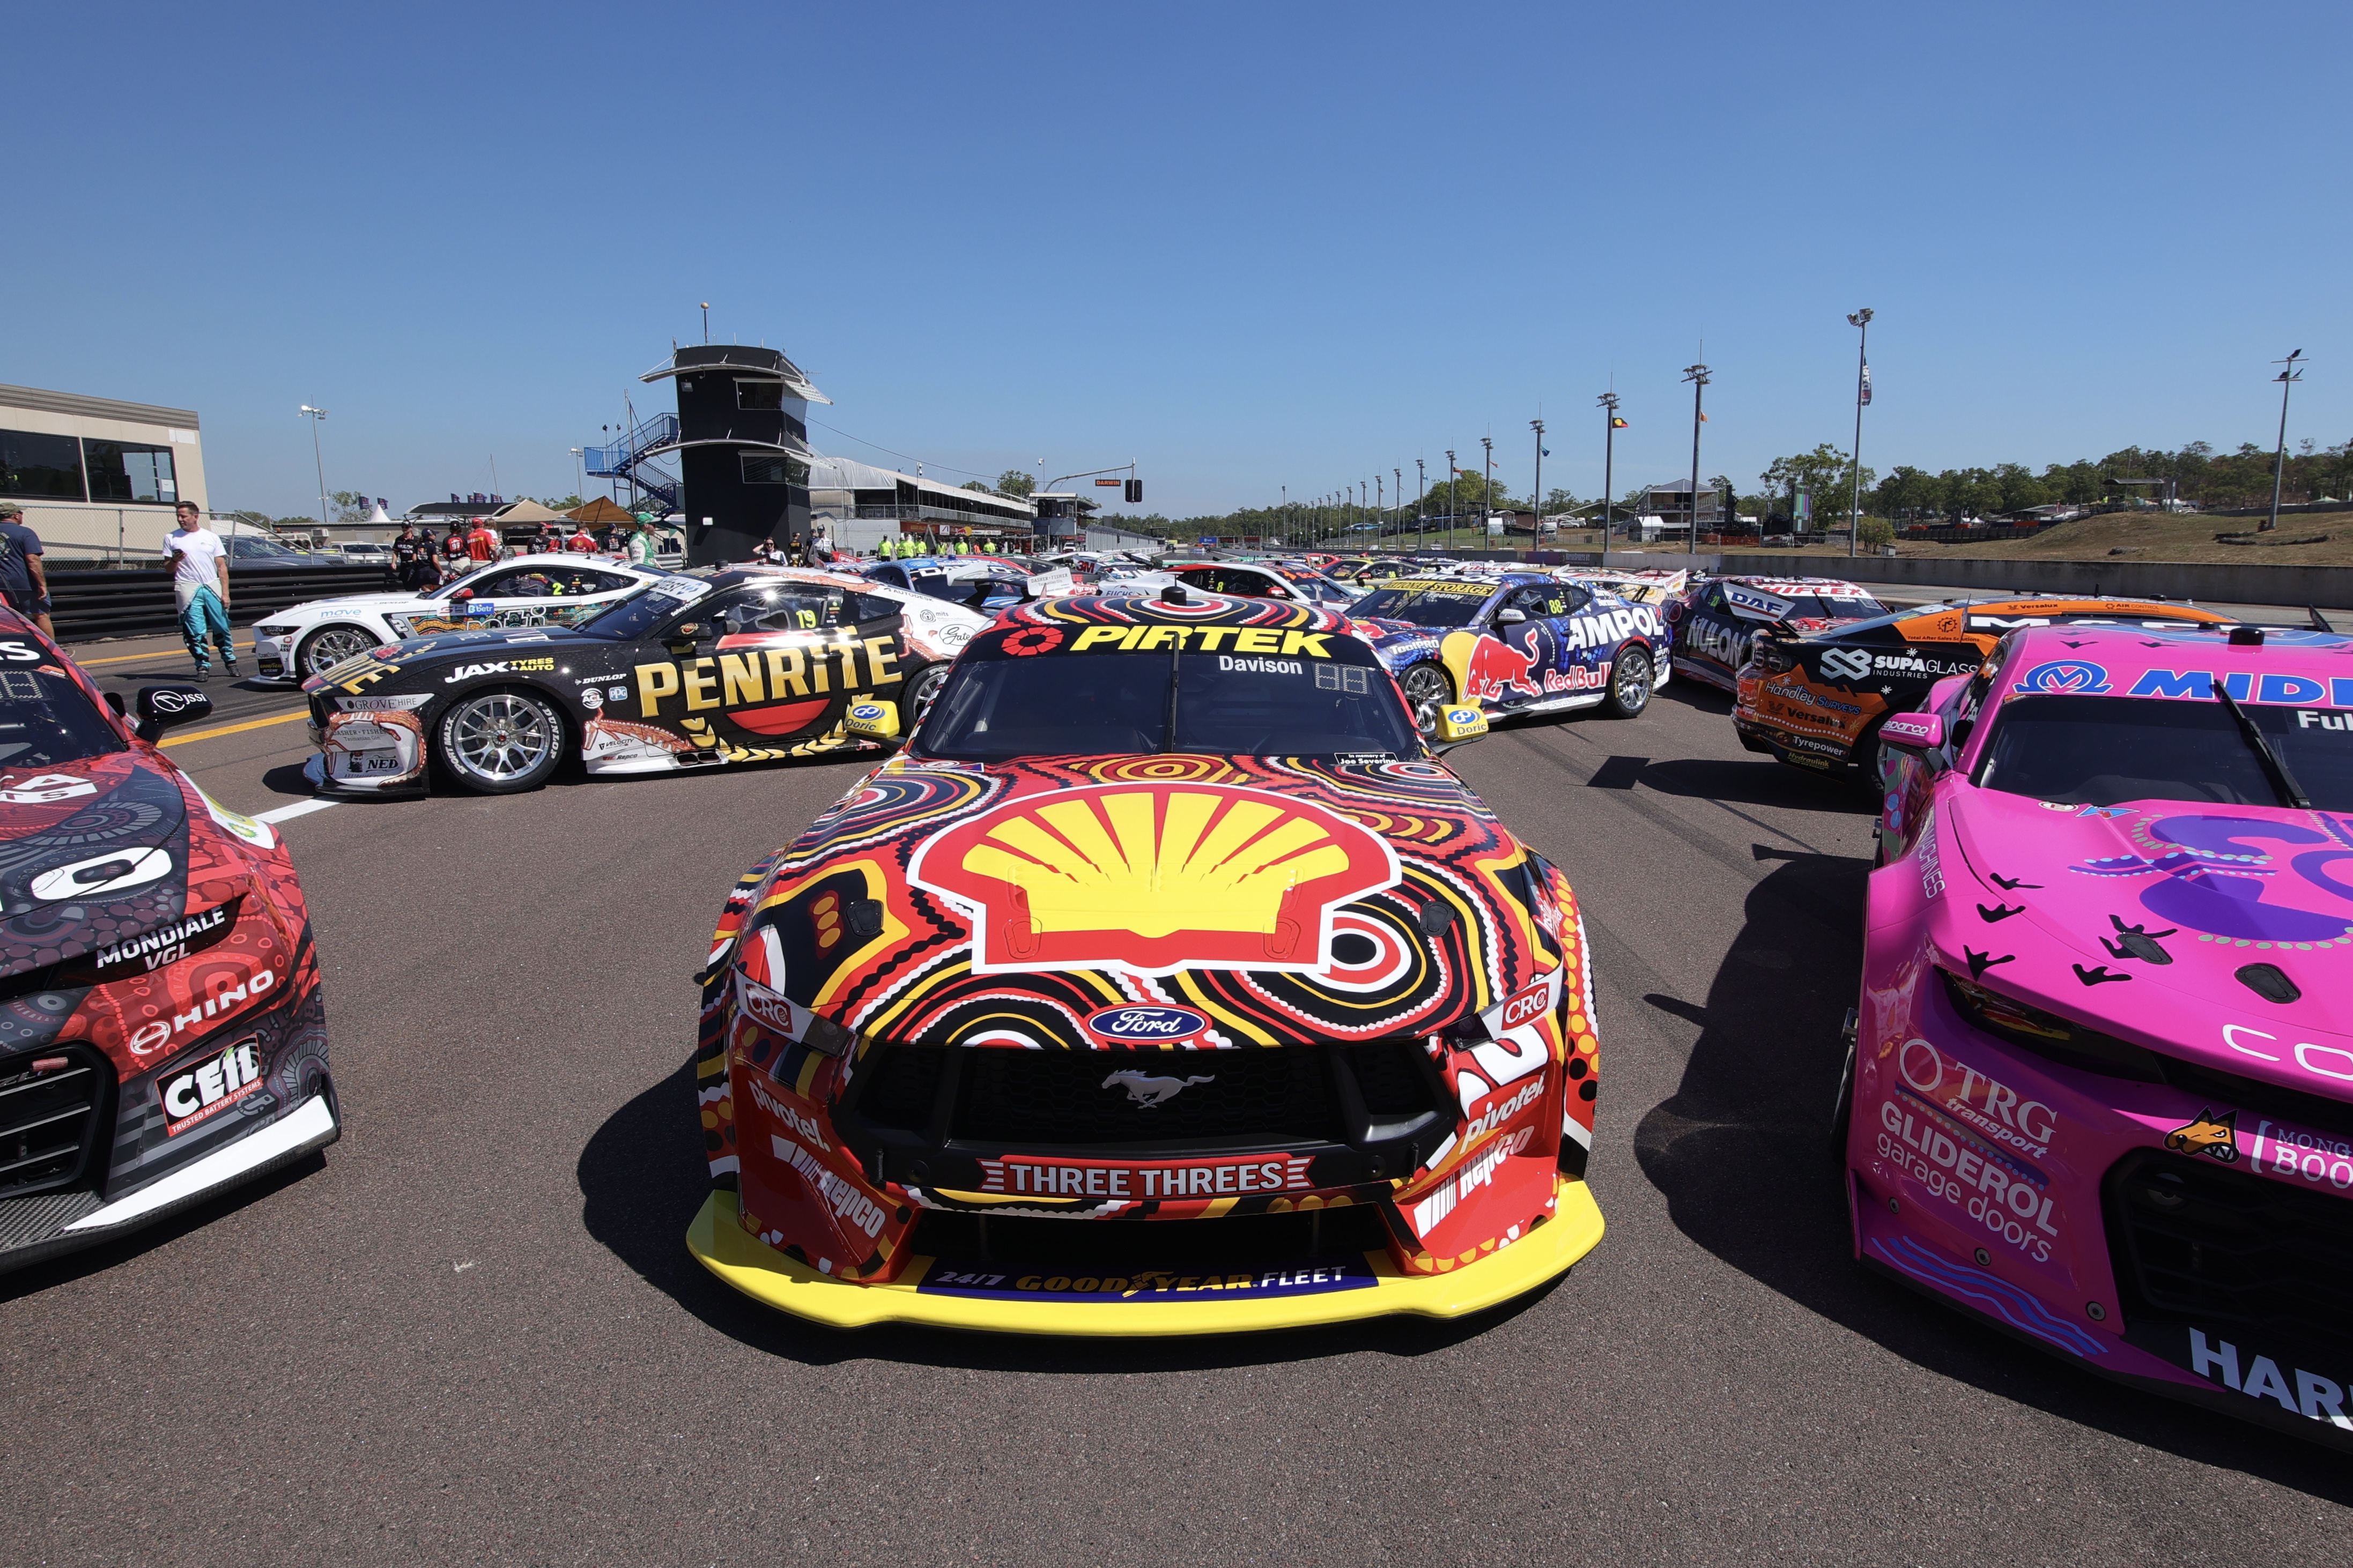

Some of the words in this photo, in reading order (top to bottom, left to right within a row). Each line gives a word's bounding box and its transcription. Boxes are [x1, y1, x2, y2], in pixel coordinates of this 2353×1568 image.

[1076, 561, 1095, 573] 3M
[552, 583, 562, 596] 2
[893, 589, 934, 603] AUTODESK
[1216, 581, 1224, 592] 8
[1427, 591, 1464, 601] Feeney
[1430, 582, 1493, 595] STORAGE
[671, 597, 702, 616] SafetyCulture
[1549, 599, 1563, 614] 88
[1731, 592, 1783, 612] DAF
[321, 609, 361, 618] move
[796, 610, 817, 629] 19
[942, 626, 973, 644] Gate
[1566, 607, 1664, 652] AMPOL
[1069, 626, 1334, 658] PIRTEK
[1390, 639, 1440, 655] ToolPRO
[1686, 615, 1747, 670] NULON
[445, 661, 510, 683] JAX
[510, 657, 554, 666] TYRES
[929, 666, 949, 676] SPOR
[1219, 656, 1303, 675] Davison
[1873, 670, 1928, 679] INDUSTRIES
[1874, 656, 1979, 675] SUPAGLASS
[582, 673, 627, 684] DUNLOP
[634, 636, 903, 718] PENRITE
[183, 692, 208, 704] JSSI
[582, 694, 604, 703] ACL
[610, 688, 626, 699] PPG
[1765, 681, 1816, 707] Handley
[354, 699, 396, 710] GROVE
[398, 698, 417, 706] HIRE
[845, 718, 877, 731] Doric
[1787, 707, 1846, 730] Versalux
[1882, 719, 1929, 735] sparco
[443, 717, 455, 747] MAXX
[542, 708, 560, 760] DUNLOP
[1457, 723, 1487, 735] Doric
[606, 738, 634, 747] VELOCITY
[1793, 735, 1844, 756] Tyrepower
[367, 759, 399, 769] NED
[445, 747, 469, 775] SPORT
[1787, 752, 1830, 768] Hydraulink
[96, 906, 226, 969] MONDIALE
[144, 942, 191, 971] VGL
[175, 970, 275, 1031] HINO
[749, 989, 791, 1028] CRC
[1505, 987, 1547, 1024] CRC
[1112, 1005, 1182, 1034] Ford
[172, 1111, 204, 1133] TRUSTED
[204, 1095, 233, 1118] BATTERY
[233, 1079, 261, 1102] SYSTEMS
[1955, 1064, 2059, 1146] TRG
[1946, 1095, 2048, 1159] transport
[1880, 1101, 2059, 1236] GLIDEROL
[1009, 1164, 1132, 1198] THREE
[1139, 1162, 1284, 1197] THREES
[1876, 1132, 1962, 1206] garage
[1966, 1192, 2052, 1263] doors
[936, 1271, 1008, 1287] 24/7
[1261, 1266, 1346, 1287] FLEET
[2189, 1327, 2353, 1432] HAR
